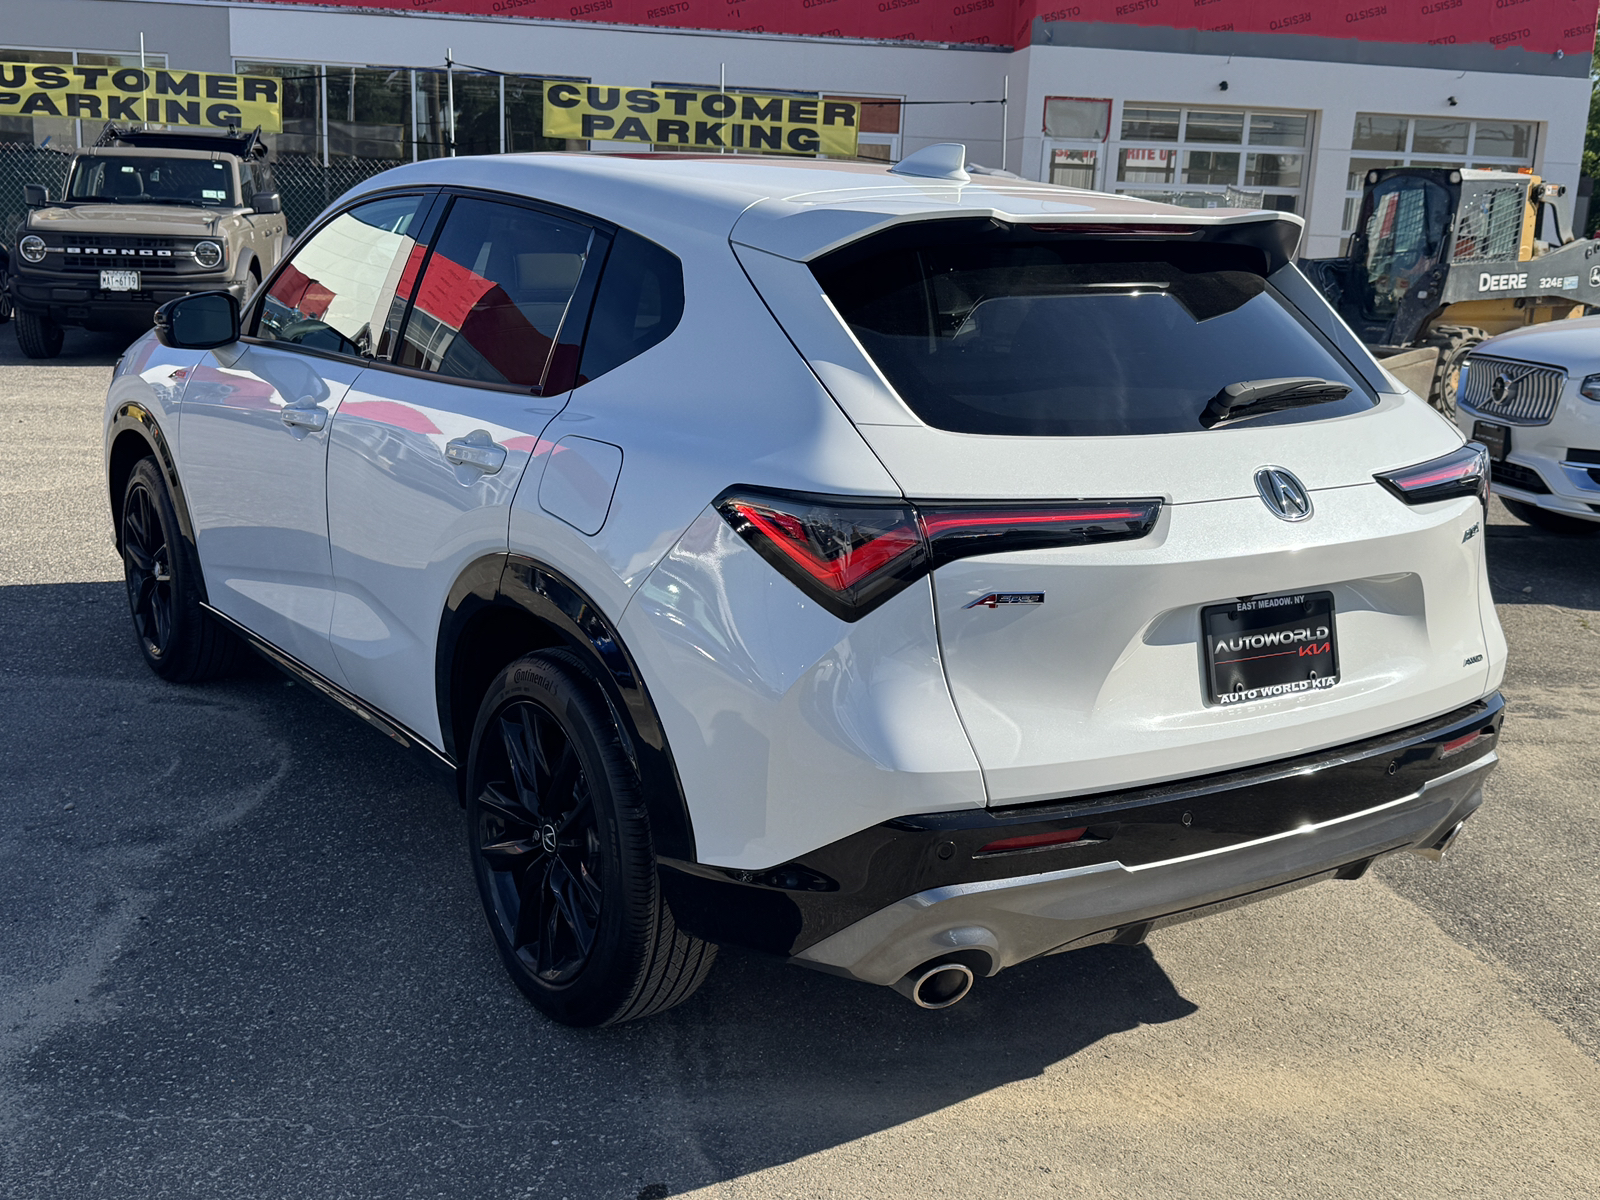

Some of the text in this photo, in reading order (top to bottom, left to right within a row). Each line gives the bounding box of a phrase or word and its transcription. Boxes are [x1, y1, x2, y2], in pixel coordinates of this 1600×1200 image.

[570, 0, 613, 17] RESISTO
[647, 1, 690, 19] RESISTO
[953, 0, 995, 16] RESISTO
[1041, 6, 1081, 23] ESISTO
[1116, 0, 1159, 17] RESISTO
[1345, 5, 1387, 23] RESISTO
[1269, 12, 1312, 30] RESISTO
[1489, 28, 1531, 45] RESISTO
[547, 84, 855, 127] CUSTOMER
[581, 113, 820, 152] PARKING
[67, 247, 172, 256] BRONCO
[1479, 273, 1528, 291] DEERE
[1539, 277, 1563, 288] 324E
[1237, 601, 1256, 611] EAST
[1294, 595, 1305, 604] NY
[1215, 626, 1329, 654] AUTOWORLD
[1299, 642, 1331, 656] KIA
[513, 668, 554, 693] Continental
[1220, 676, 1336, 704] AUTO WORLD KIA
